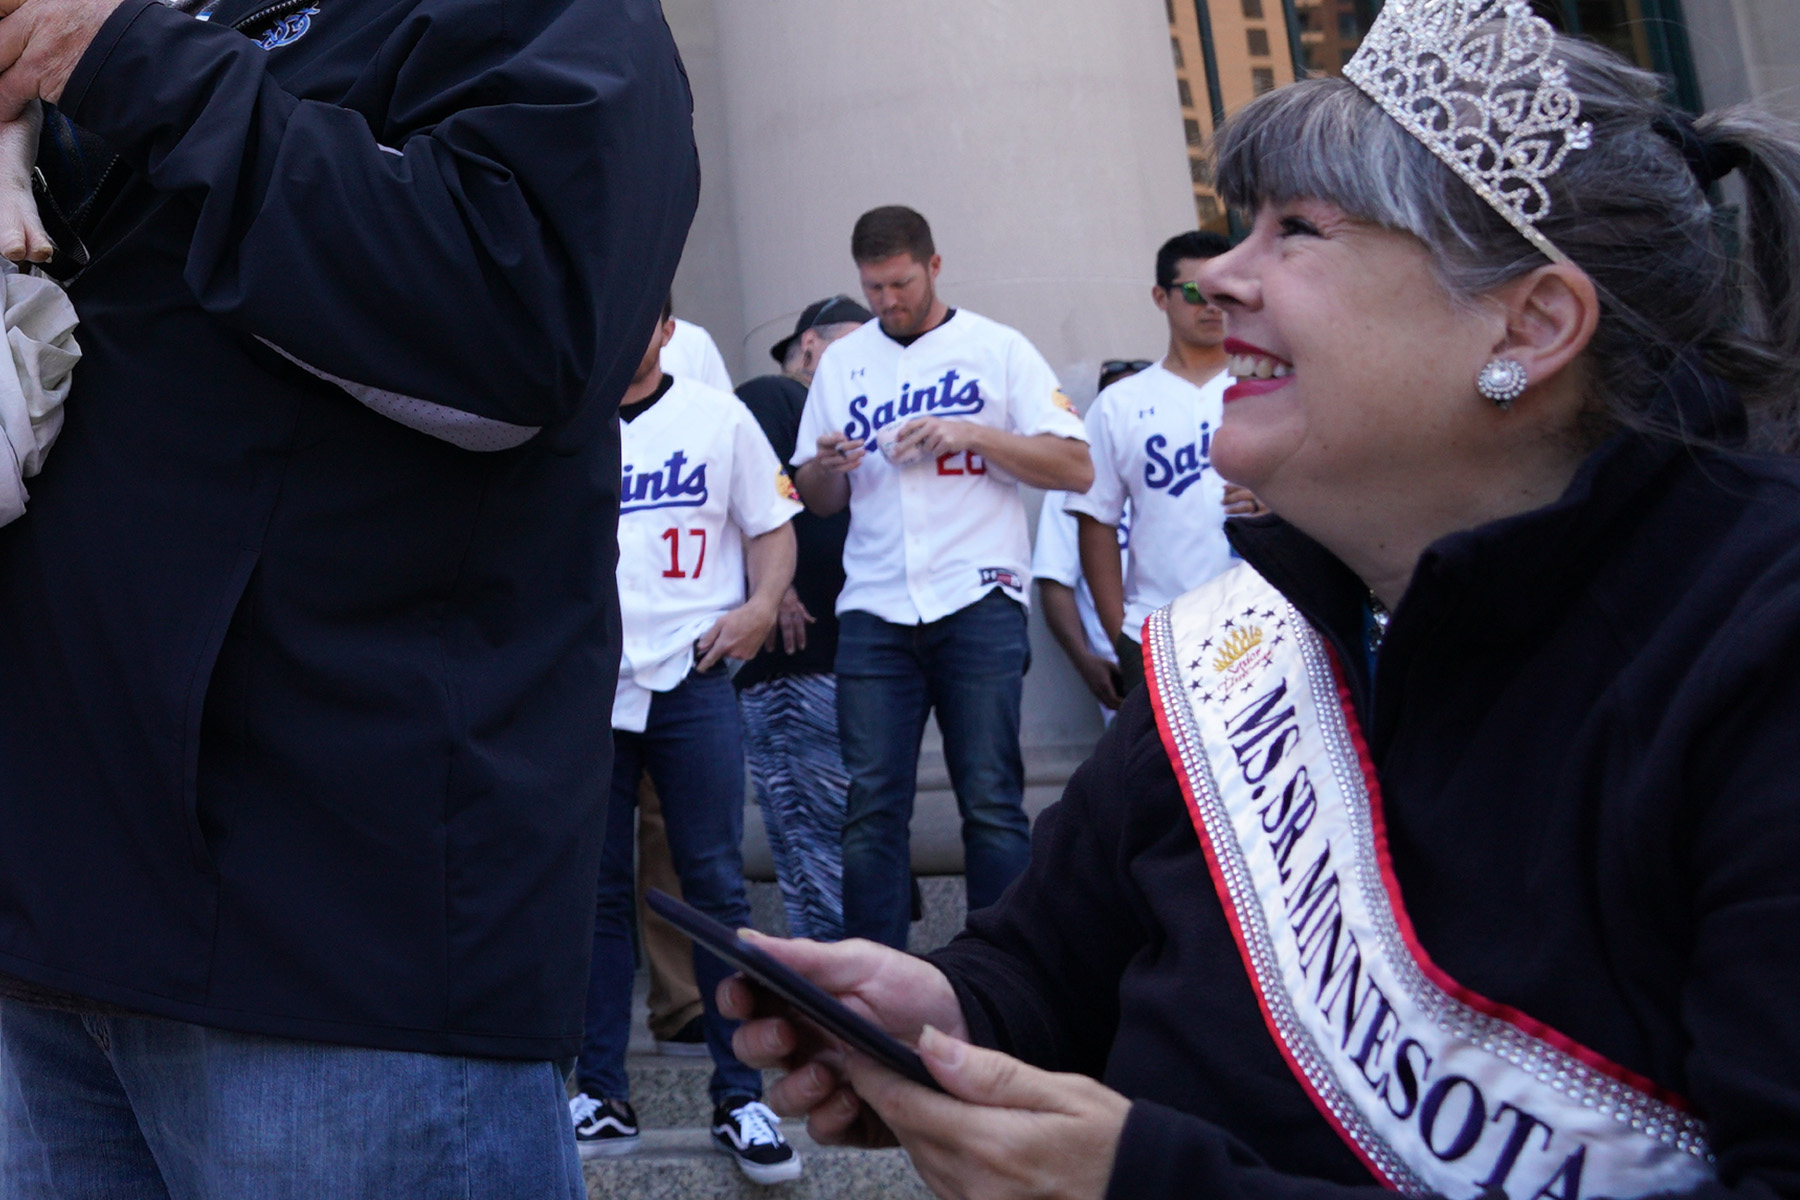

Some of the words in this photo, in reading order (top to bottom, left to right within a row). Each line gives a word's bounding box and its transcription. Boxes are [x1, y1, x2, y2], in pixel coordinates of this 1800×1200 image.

[845, 369, 984, 444] Saints
[621, 450, 708, 506] ints
[1145, 421, 1211, 490] Sai
[661, 527, 706, 579] 17
[1225, 677, 1299, 800] MS.
[1257, 765, 1317, 885] SR.
[1284, 838, 1588, 1200] MINNESOTA
